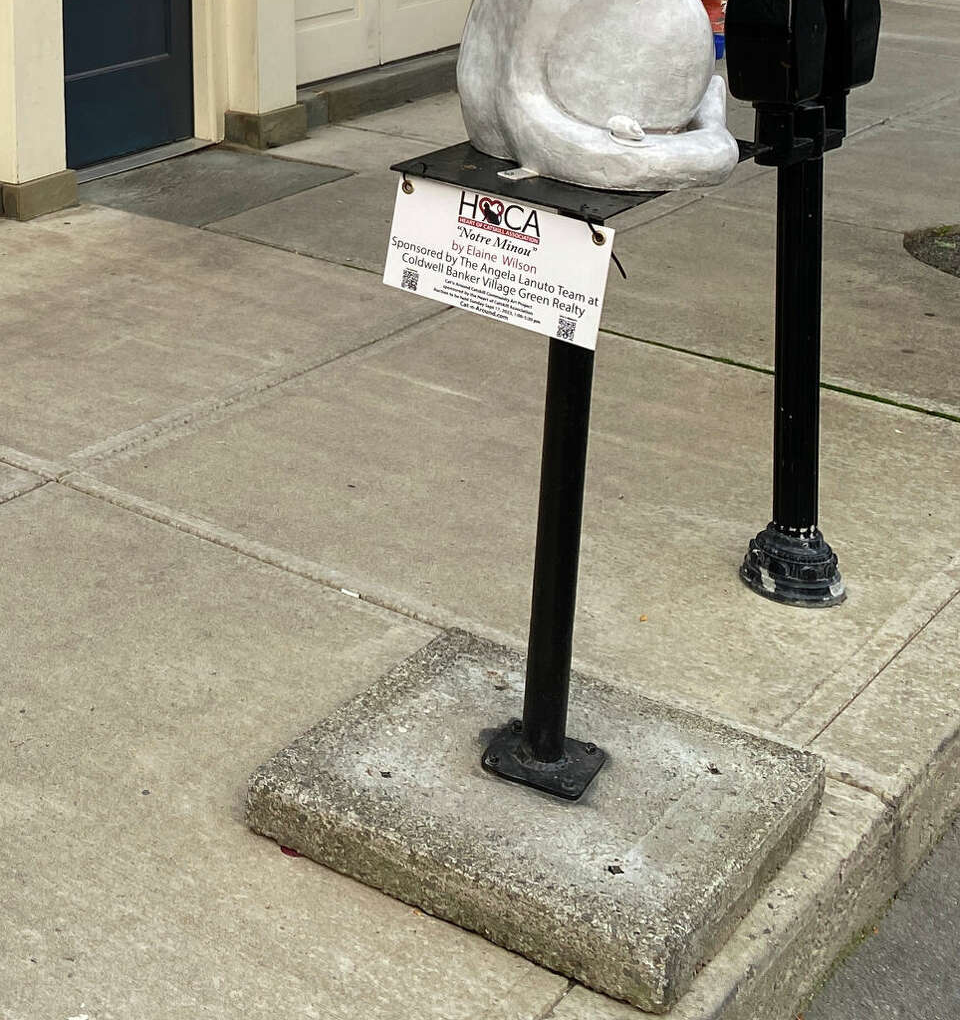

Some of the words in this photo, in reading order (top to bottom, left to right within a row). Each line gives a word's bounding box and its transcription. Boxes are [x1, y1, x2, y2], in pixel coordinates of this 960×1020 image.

[391, 235, 443, 259] Sponsored
[445, 251, 457, 266] by
[460, 255, 477, 270] The
[479, 262, 515, 281] Angela
[518, 273, 554, 293] Lanuto
[557, 284, 585, 302] Team
[401, 252, 443, 272] Coldwell
[445, 265, 480, 283] Banker
[482, 276, 516, 296] Village
[518, 287, 549, 305] Green
[552, 297, 585, 318] Realty
[451, 240, 464, 253] by
[466, 244, 497, 262] Elaine
[502, 255, 536, 273] Wilson
